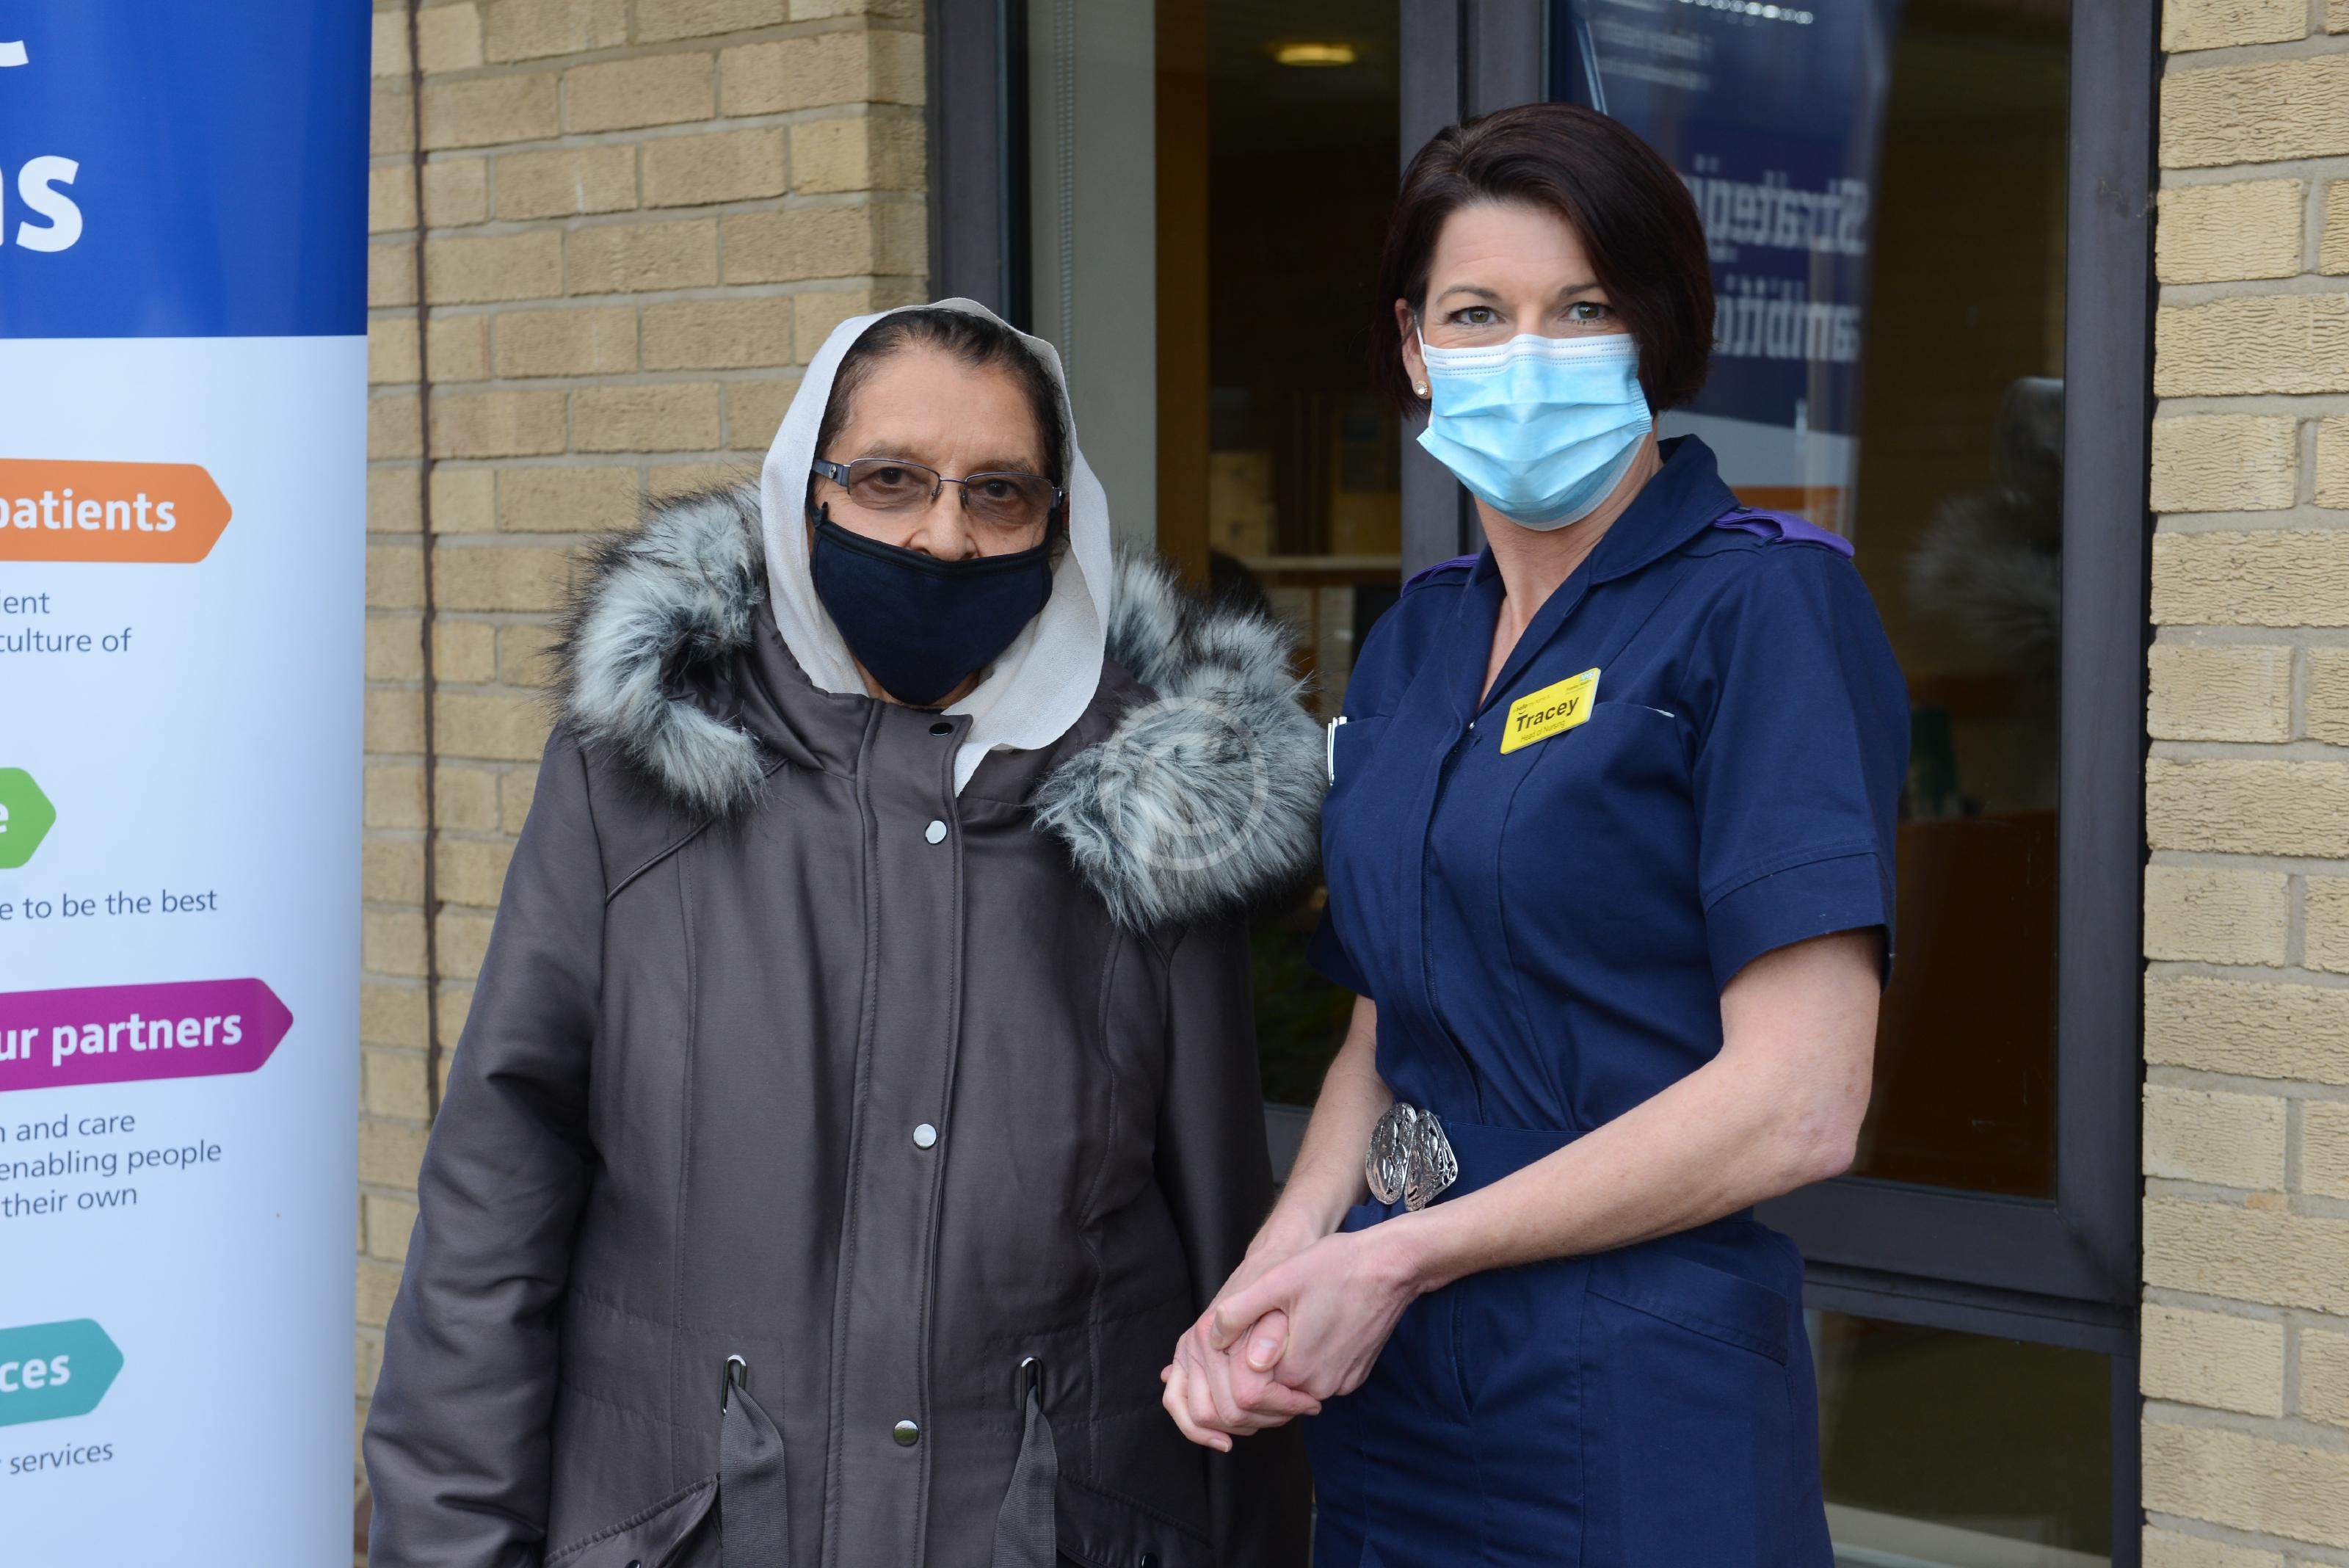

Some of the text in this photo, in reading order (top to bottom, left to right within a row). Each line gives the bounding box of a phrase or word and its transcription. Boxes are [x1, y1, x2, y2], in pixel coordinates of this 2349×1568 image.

[0, 591, 51, 614] ent
[101, 626, 132, 653] of
[1517, 696, 1579, 733] Tracey
[23, 898, 52, 919] to
[62, 893, 95, 918] be
[105, 890, 151, 915] the
[161, 889, 217, 913] best
[52, 1012, 243, 1067] partners
[16, 1113, 68, 1141] and
[78, 1114, 136, 1136] care
[0, 1139, 222, 1181] enabling people
[1, 1187, 137, 1218] their own
[10, 1442, 114, 1476] services
